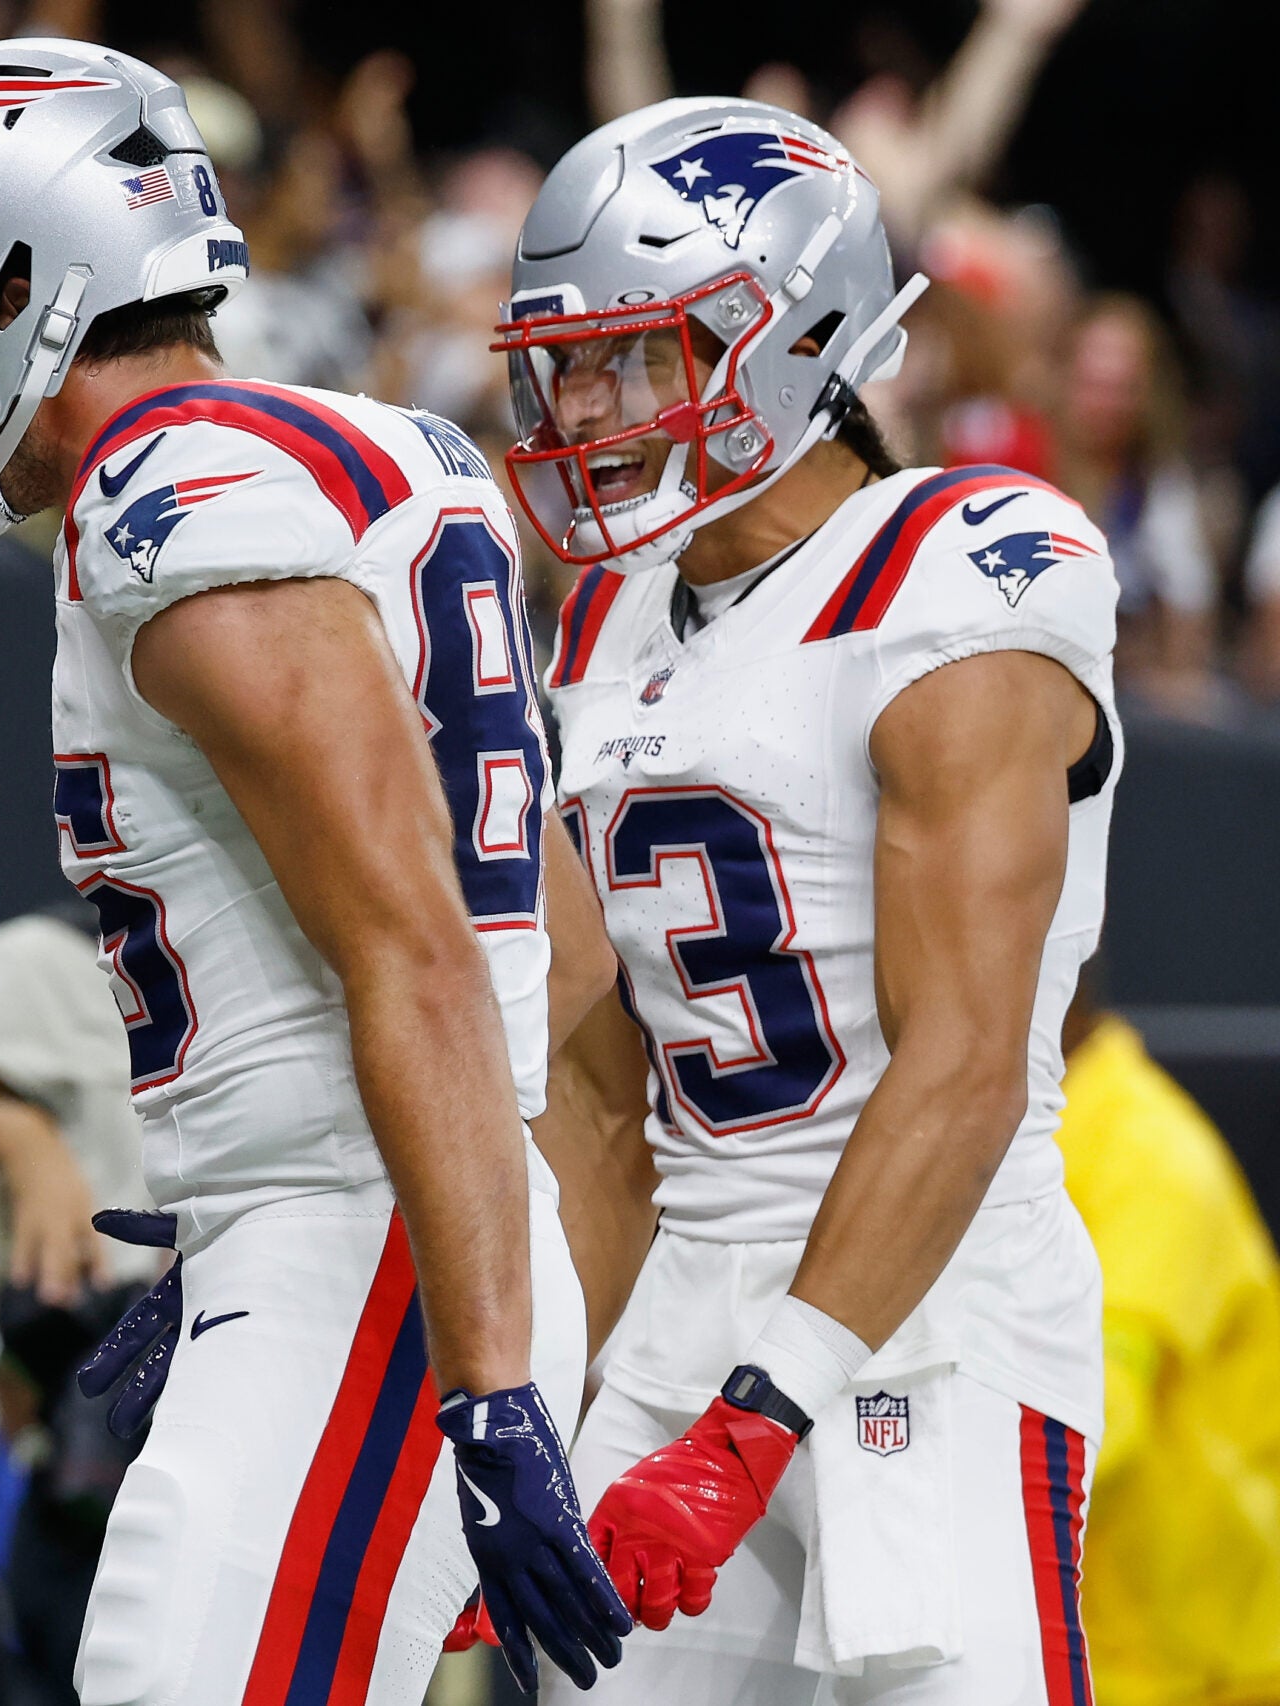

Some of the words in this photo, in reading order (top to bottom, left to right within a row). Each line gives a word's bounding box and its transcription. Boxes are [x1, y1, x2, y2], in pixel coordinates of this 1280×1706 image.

[409, 507, 548, 932] 8
[593, 735, 666, 766] PATRIOTS
[863, 1419, 904, 1449] NFL
